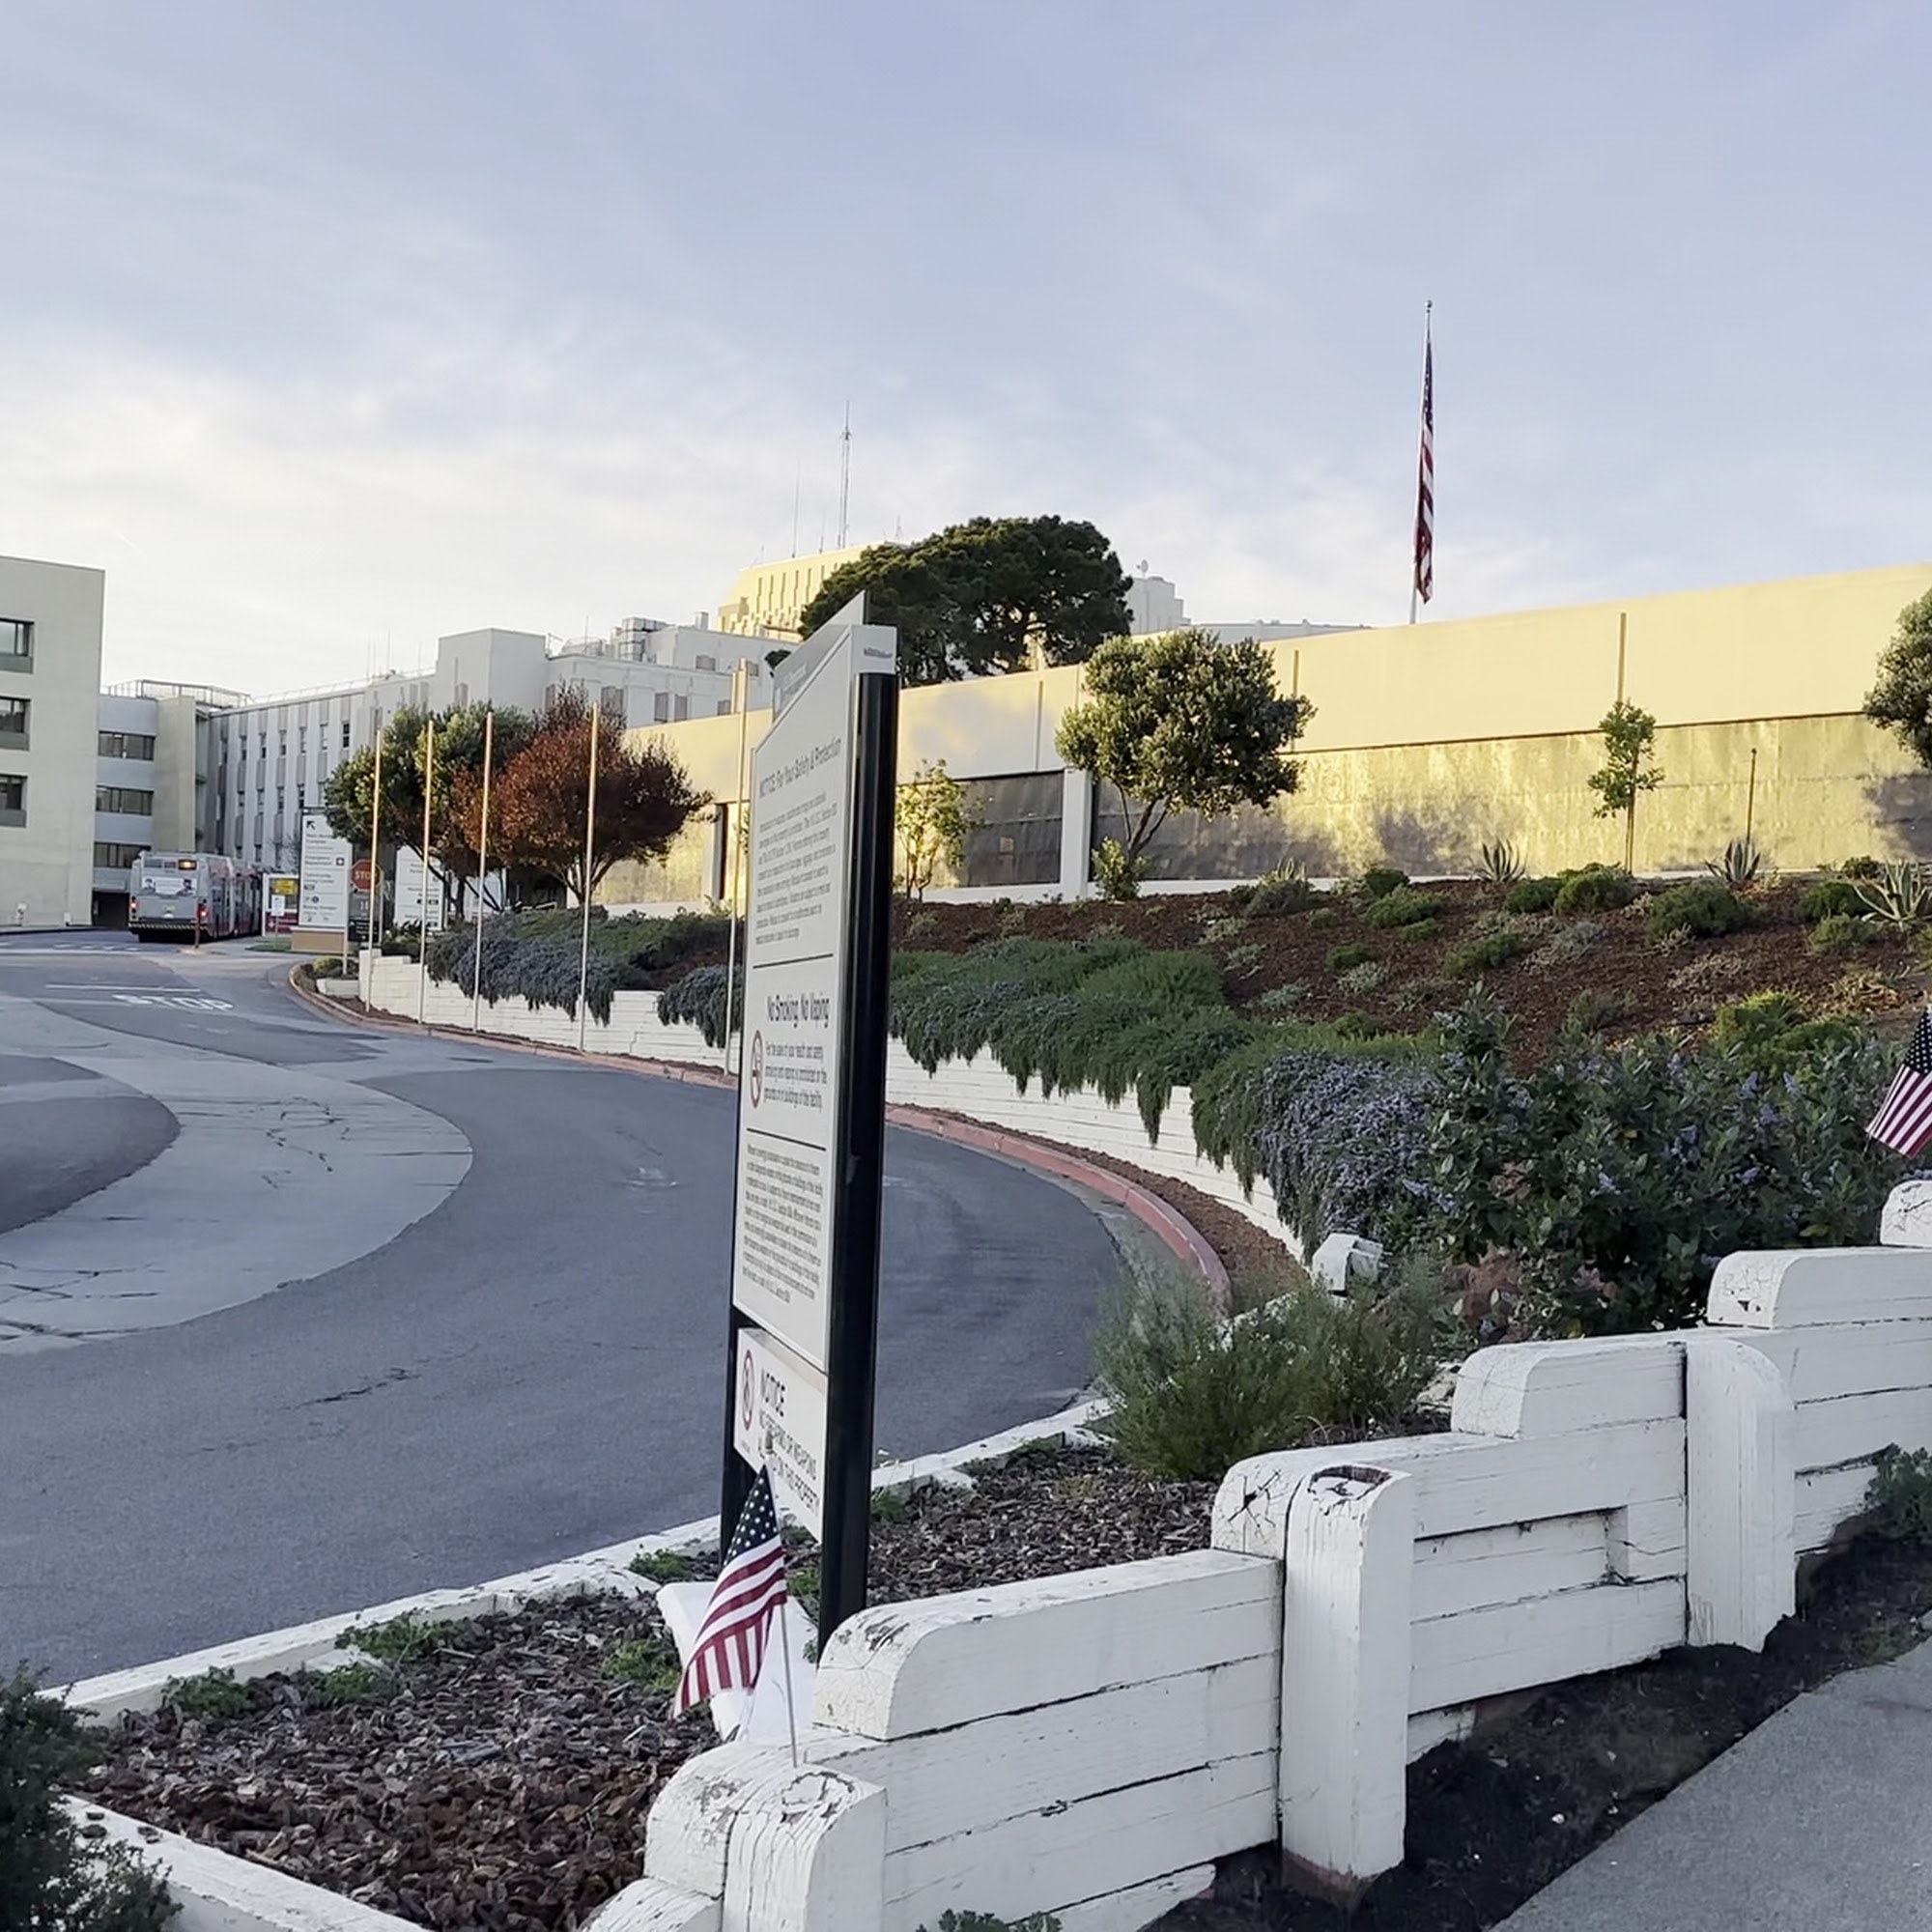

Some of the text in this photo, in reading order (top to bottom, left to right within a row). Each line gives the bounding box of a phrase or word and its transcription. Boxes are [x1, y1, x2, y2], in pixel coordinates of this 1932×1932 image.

[795, 755, 809, 779] Safety
[815, 736, 841, 766] Protection
[112, 994, 234, 1011] STOP
[767, 995, 775, 1021] No
[801, 994, 809, 1021] No
[810, 991, 830, 1030] Vaping
[761, 1367, 785, 1417] NOTICE
